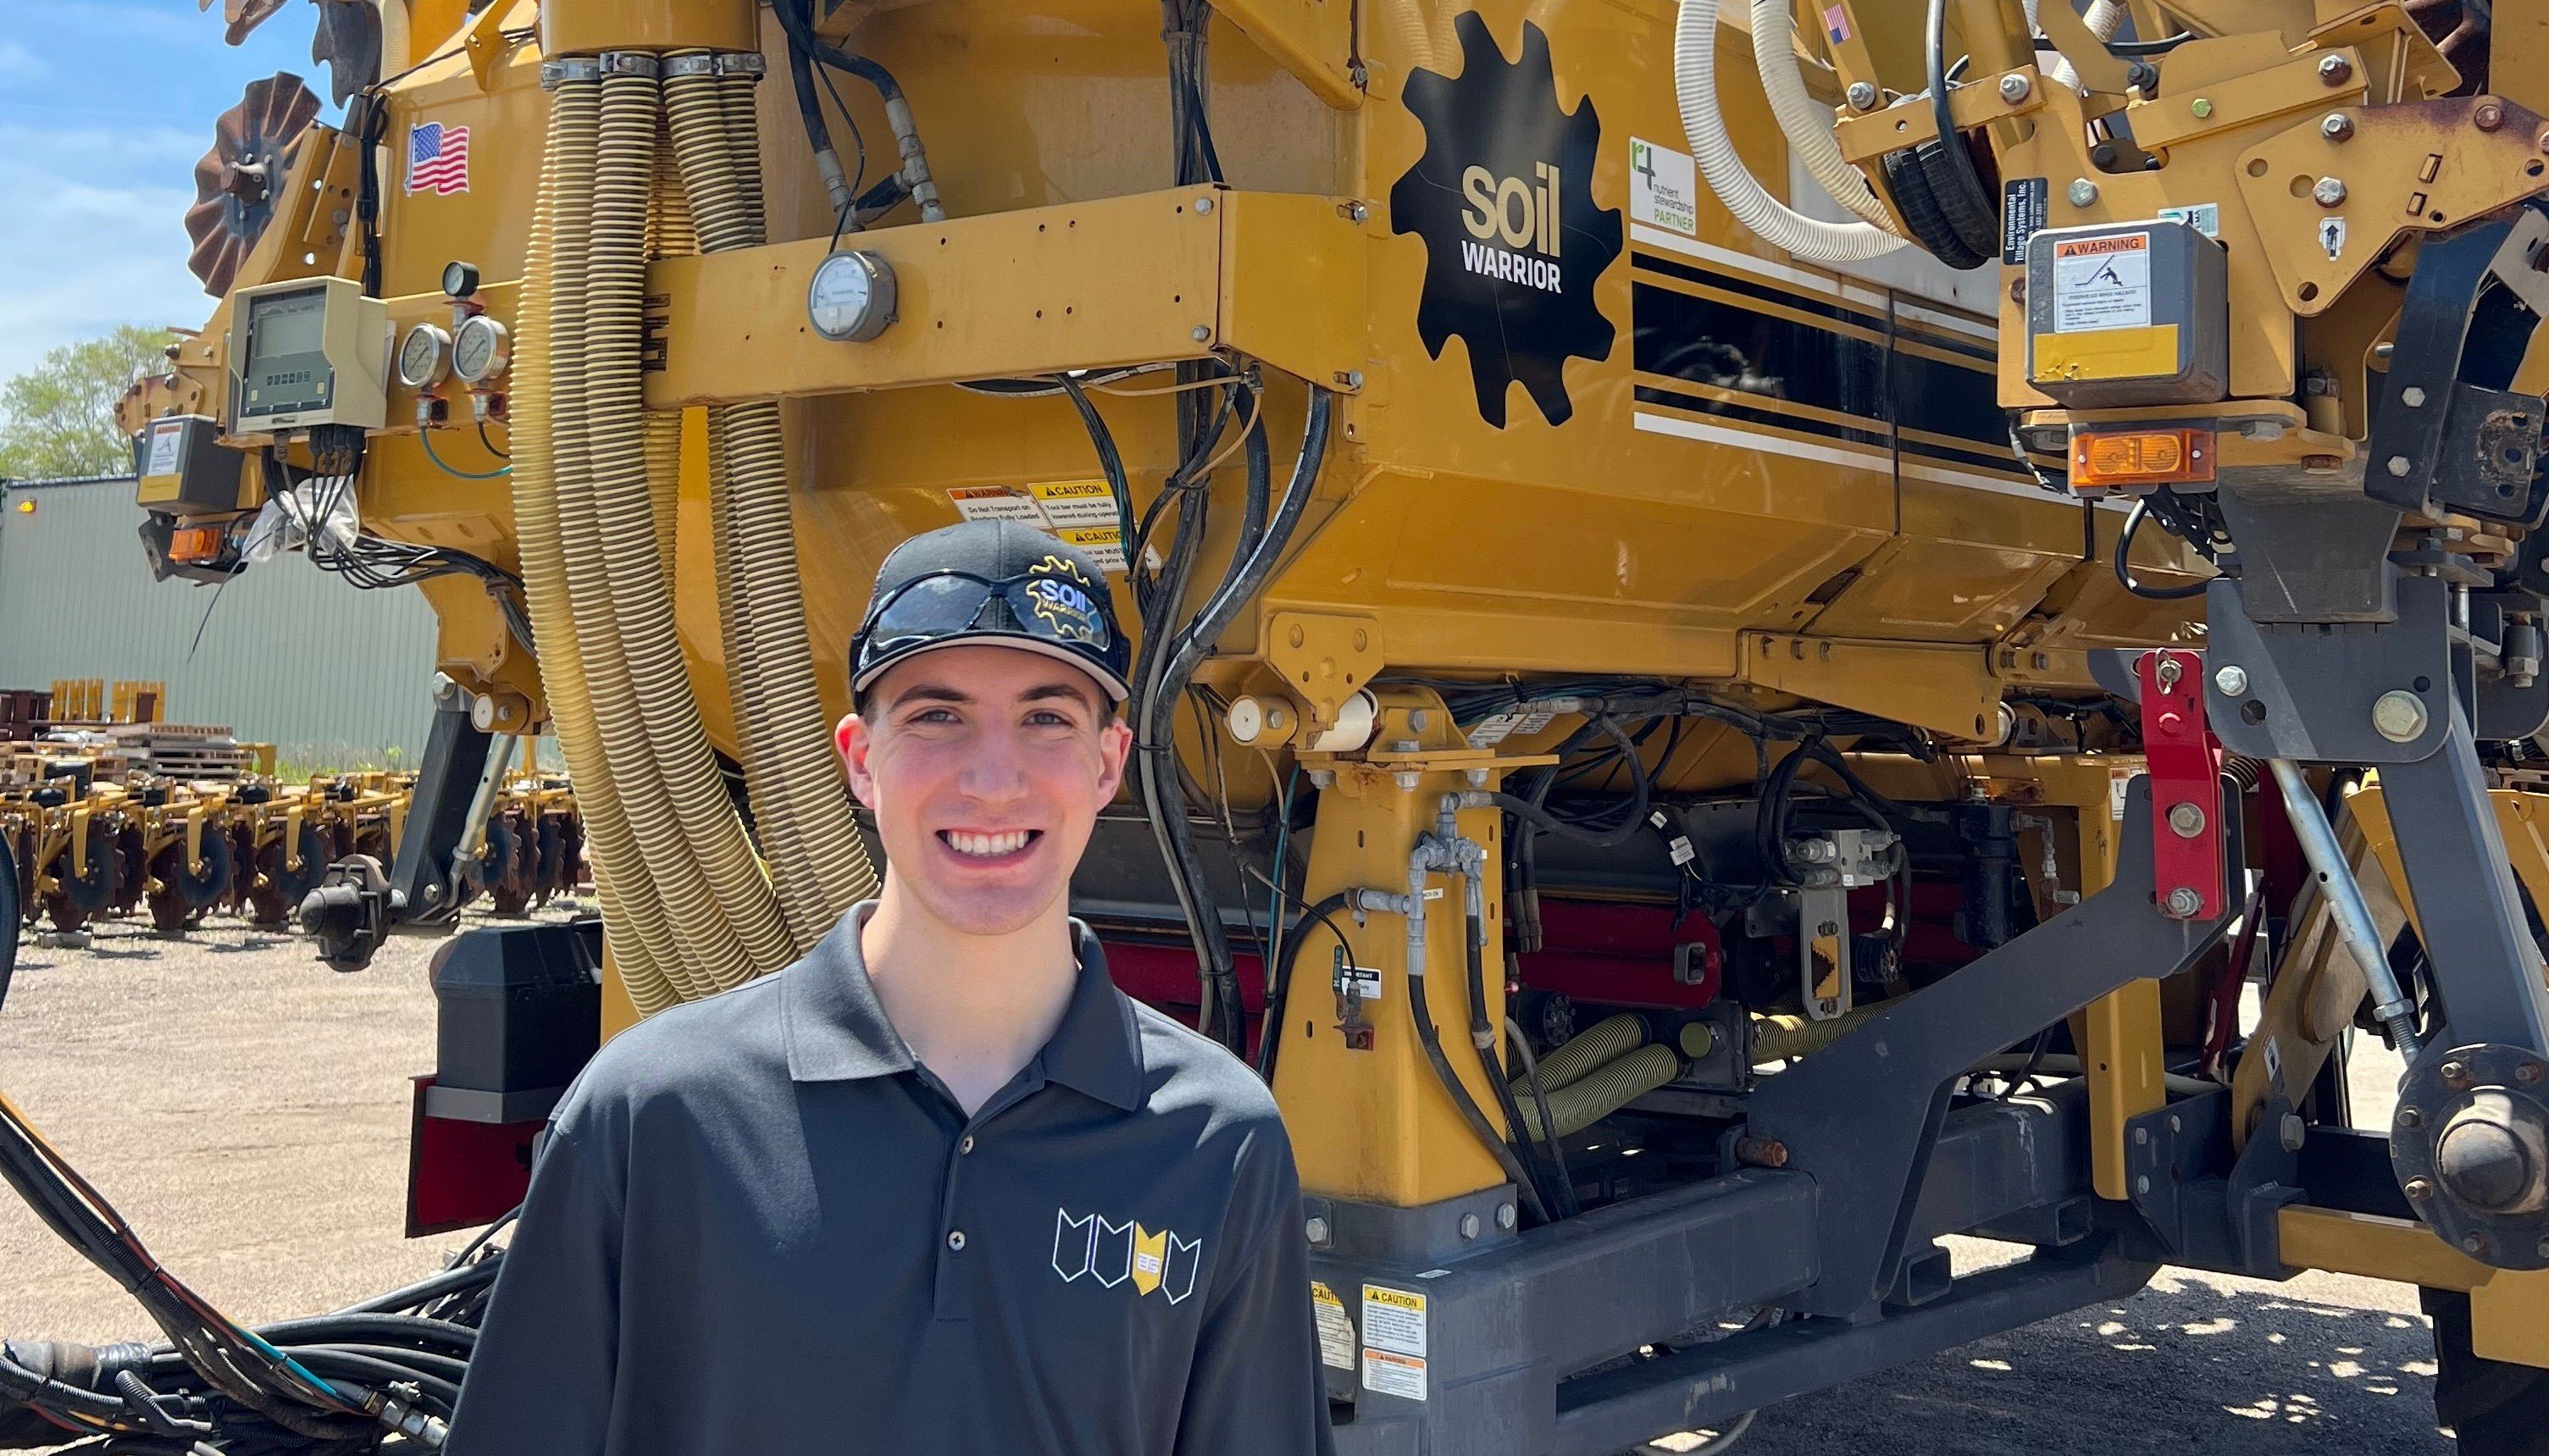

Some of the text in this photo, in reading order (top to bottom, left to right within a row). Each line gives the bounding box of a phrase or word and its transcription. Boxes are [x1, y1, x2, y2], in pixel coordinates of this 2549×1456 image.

[1653, 184, 1679, 199] nutrient
[1654, 194, 1694, 215] stewardship
[1654, 208, 1694, 232] PARTNER
[2005, 193, 2016, 251] Environmental
[2014, 180, 2027, 262] Tillage Systems, Inc.
[2078, 238, 2139, 254] WARNING
[1461, 240, 1561, 294] WARRIOR
[1055, 484, 1103, 495] CAUTION
[989, 505, 1021, 513] Transport
[1098, 510, 1119, 518] operat
[1084, 530, 1121, 541] CAUTIO
[1382, 1293, 1417, 1308] CAUTION
